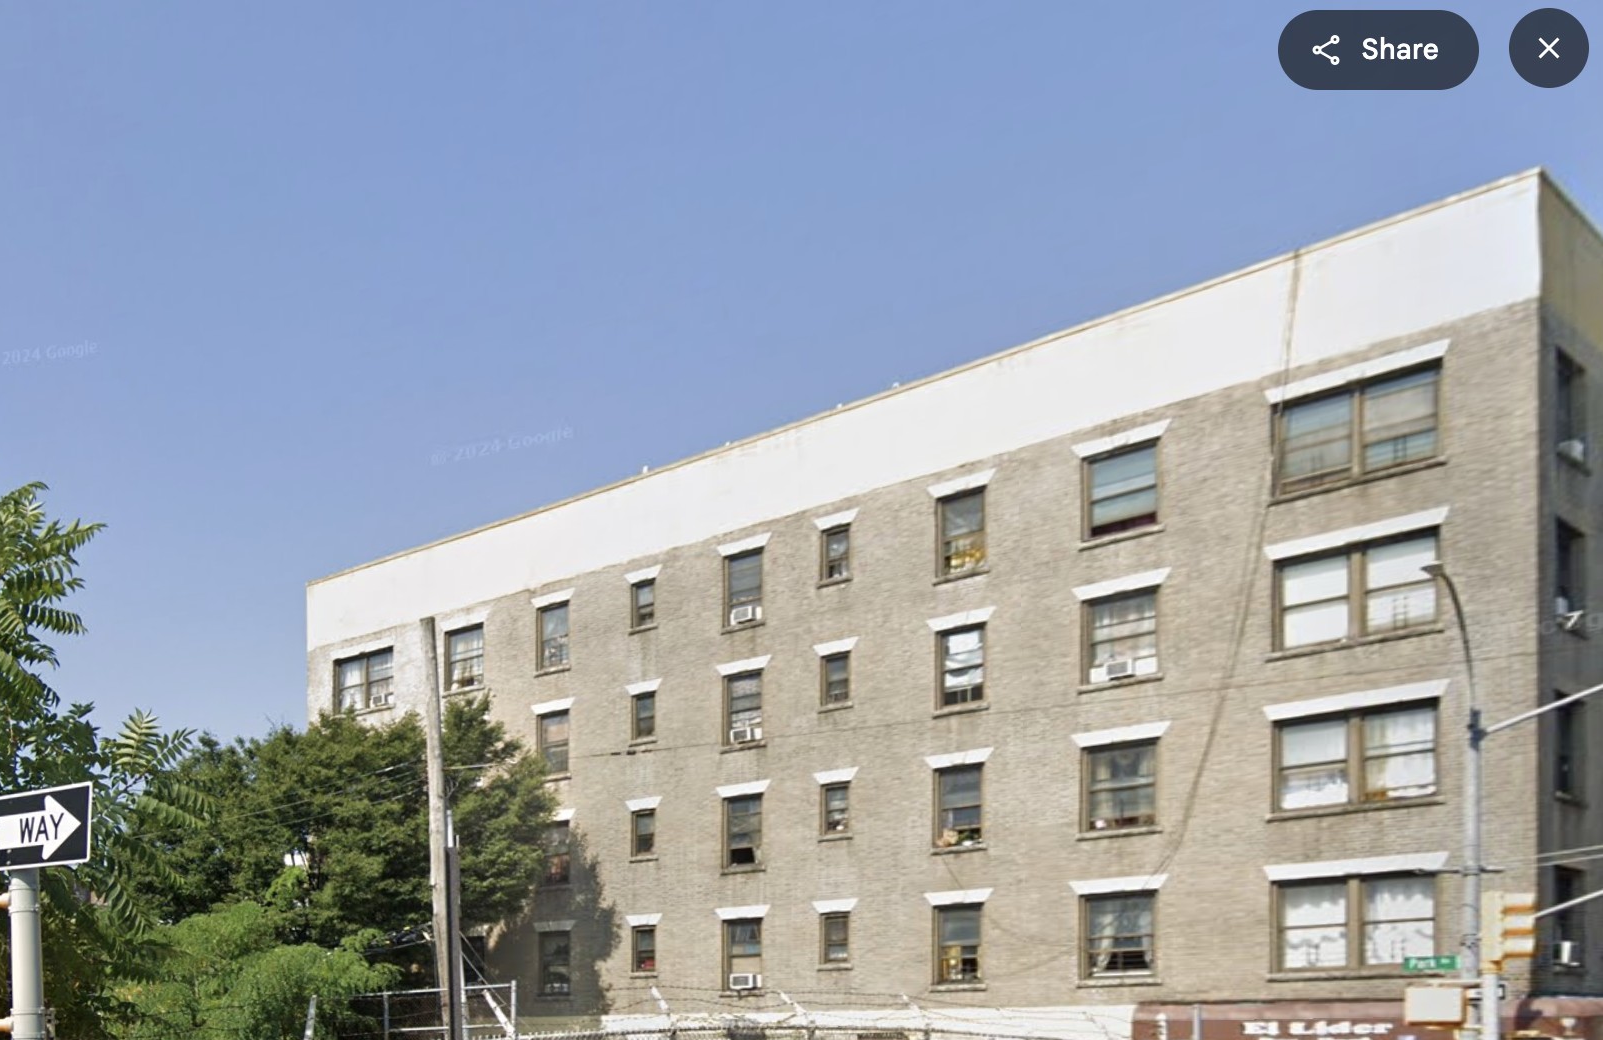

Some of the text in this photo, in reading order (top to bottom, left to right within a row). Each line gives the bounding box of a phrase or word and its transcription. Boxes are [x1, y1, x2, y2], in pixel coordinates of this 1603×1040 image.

[19, 812, 65, 845] WAY
[1409, 957, 1437, 969] Park
[1243, 1020, 1394, 1036] El Lider
